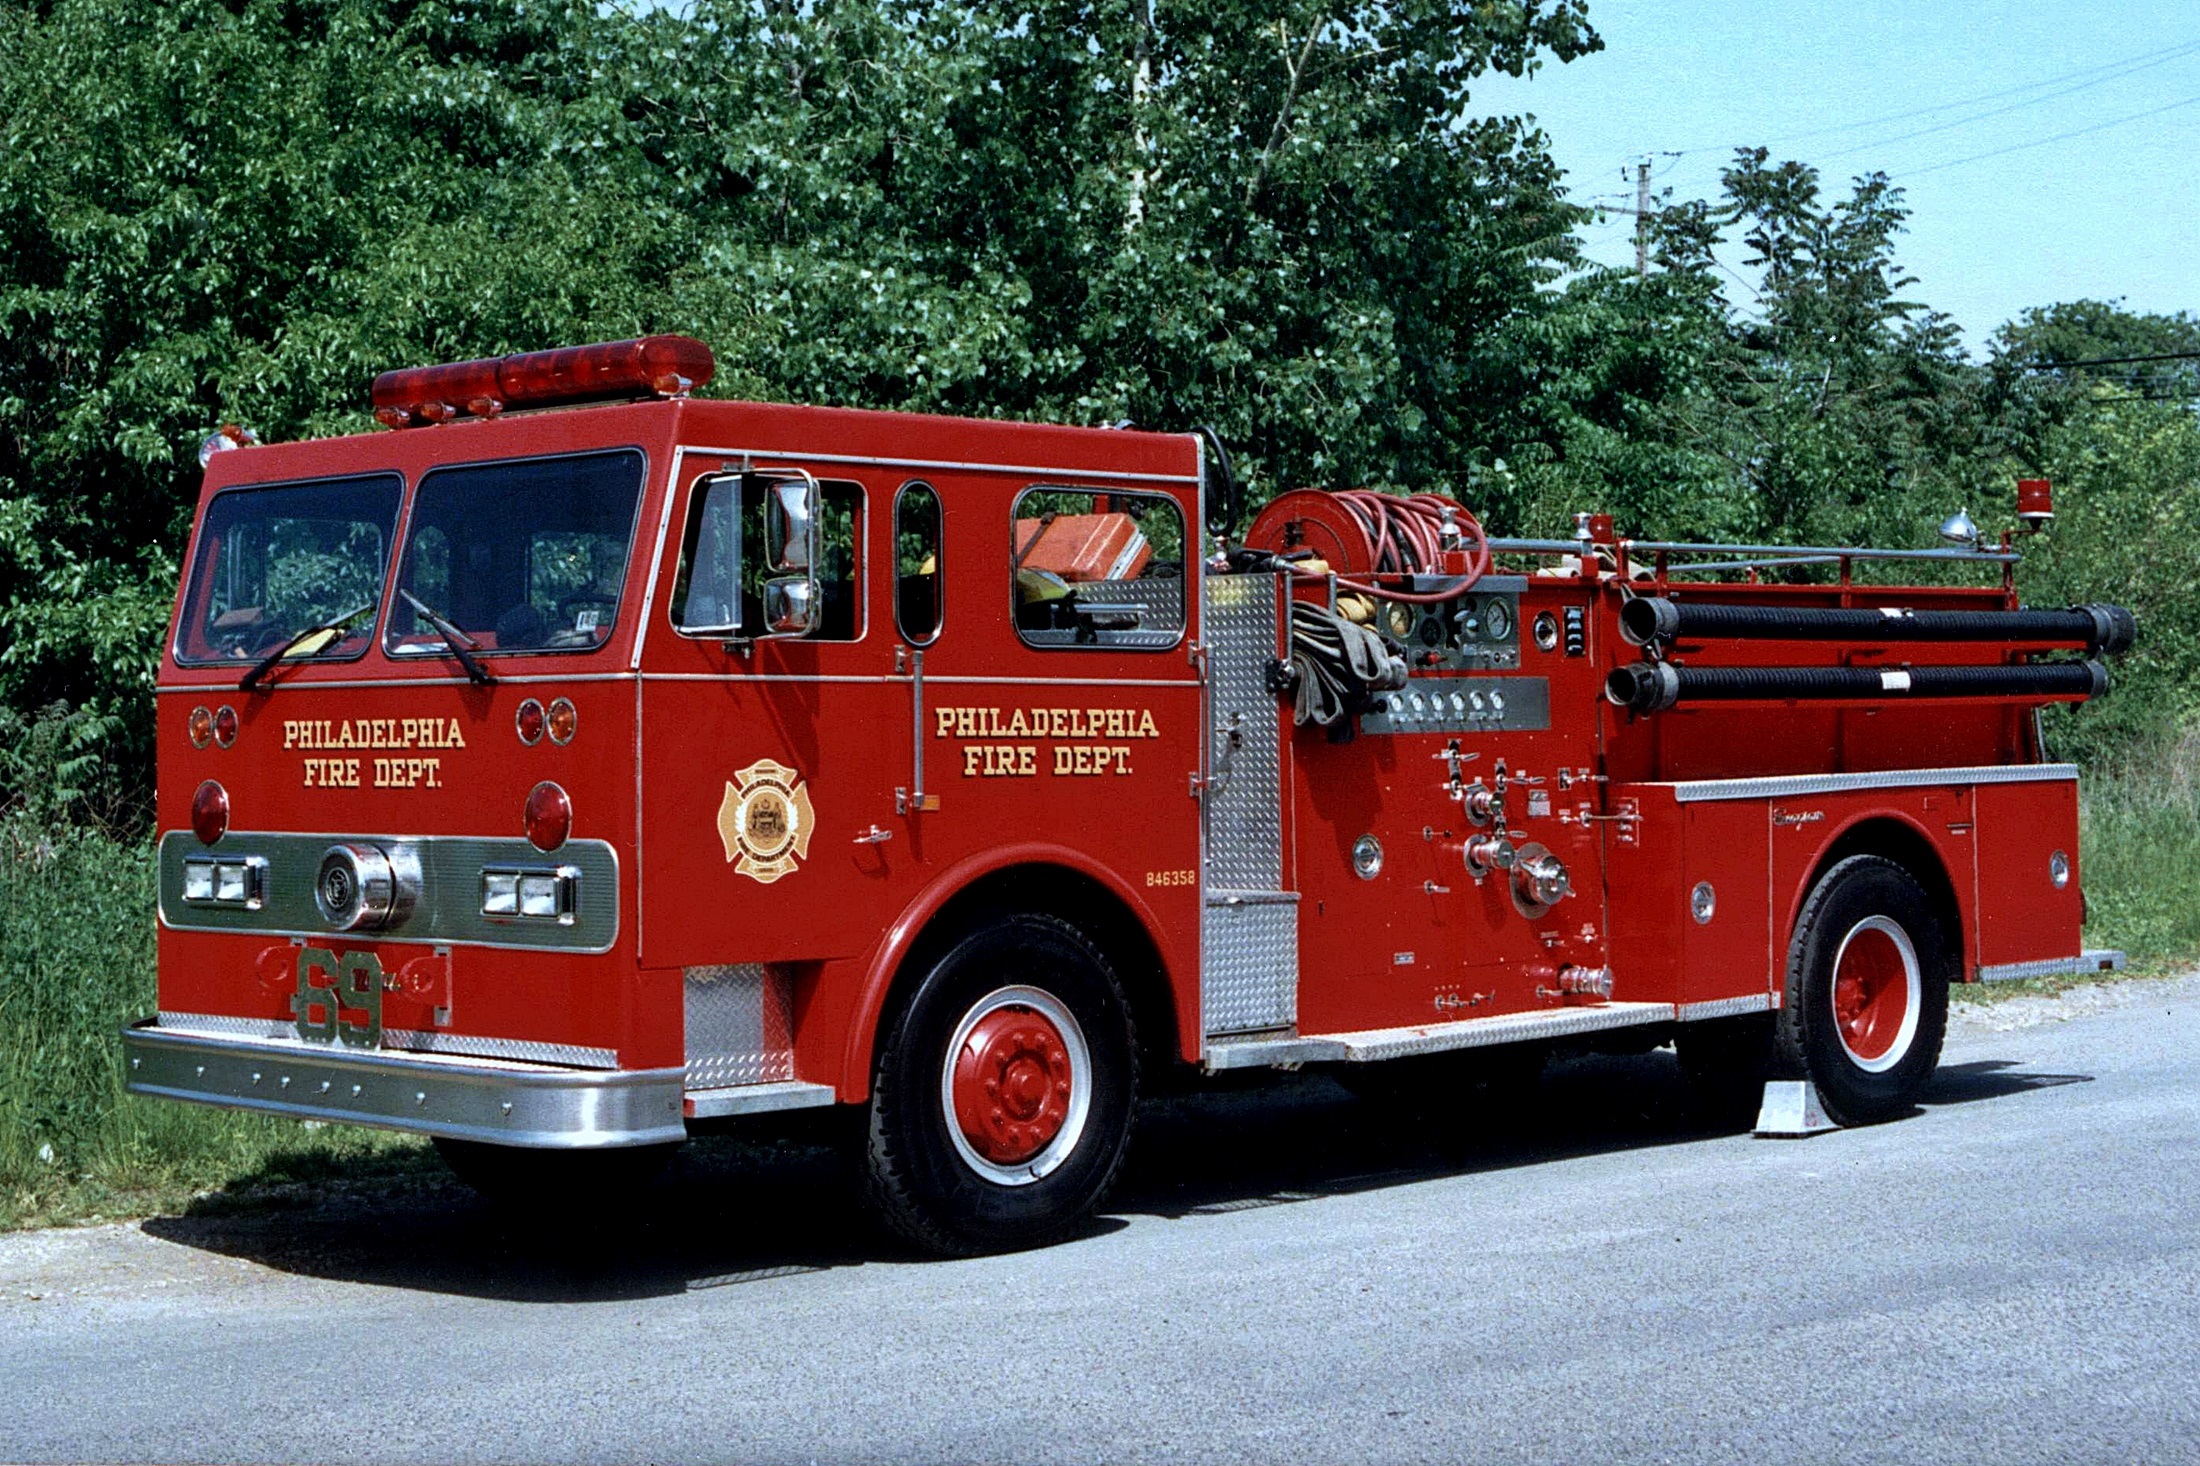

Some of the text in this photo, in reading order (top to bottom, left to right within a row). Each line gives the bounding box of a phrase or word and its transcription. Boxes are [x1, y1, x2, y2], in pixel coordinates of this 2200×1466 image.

[284, 719, 466, 748] PHILADELPHIA
[935, 707, 1160, 738] PHILADELPHIA
[304, 759, 441, 786] FIRE DEPT.
[965, 746, 1132, 776] FIRE DEPT.
[1146, 870, 1196, 887] 846358
[297, 947, 383, 1051] 69
